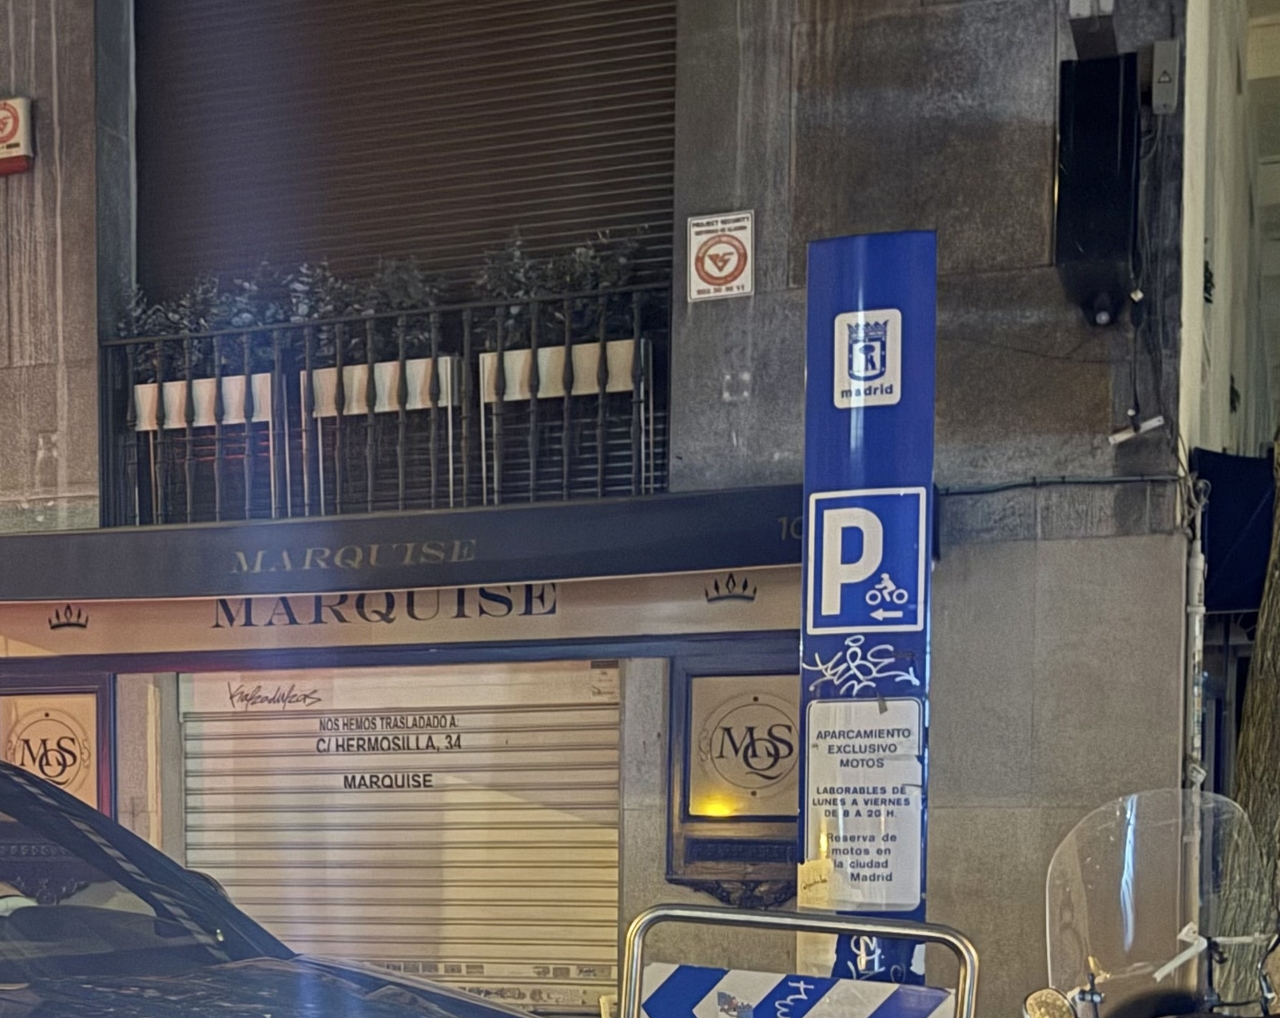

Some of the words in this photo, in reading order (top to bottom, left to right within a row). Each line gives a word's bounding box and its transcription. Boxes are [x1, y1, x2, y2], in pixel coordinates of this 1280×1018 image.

[841, 384, 893, 399] madrid
[232, 539, 477, 574] MARQUISE
[821, 507, 883, 616] P
[211, 583, 558, 628] MARQUISE
[319, 717, 339, 731] NOS
[342, 716, 377, 731] HEMOS
[379, 715, 447, 730] TRASLADADO
[816, 728, 911, 740] APARCAMIENTO
[316, 737, 331, 753] C/
[335, 734, 440, 752] HERMOSILLA,
[445, 734, 462, 750] 34
[827, 743, 897, 754] EXCLUSIVO
[839, 758, 885, 768] MOTOS
[343, 774, 433, 789] MARQUISE
[816, 786, 887, 795] LABORABLES
[892, 786, 907, 795] DE
[812, 798, 846, 806] LUNES
[851, 798, 858, 806] A
[863, 798, 910, 806] VIERNES
[824, 810, 838, 818] DE
[855, 810, 862, 818] A
[867, 810, 882, 818] 20
[827, 833, 876, 842] Reserva
[881, 833, 897, 842] de
[831, 848, 870, 856] motos
[876, 848, 891, 856] en
[834, 859, 844, 869] la
[849, 859, 888, 869] ciudad
[850, 872, 893, 882] Madrid
